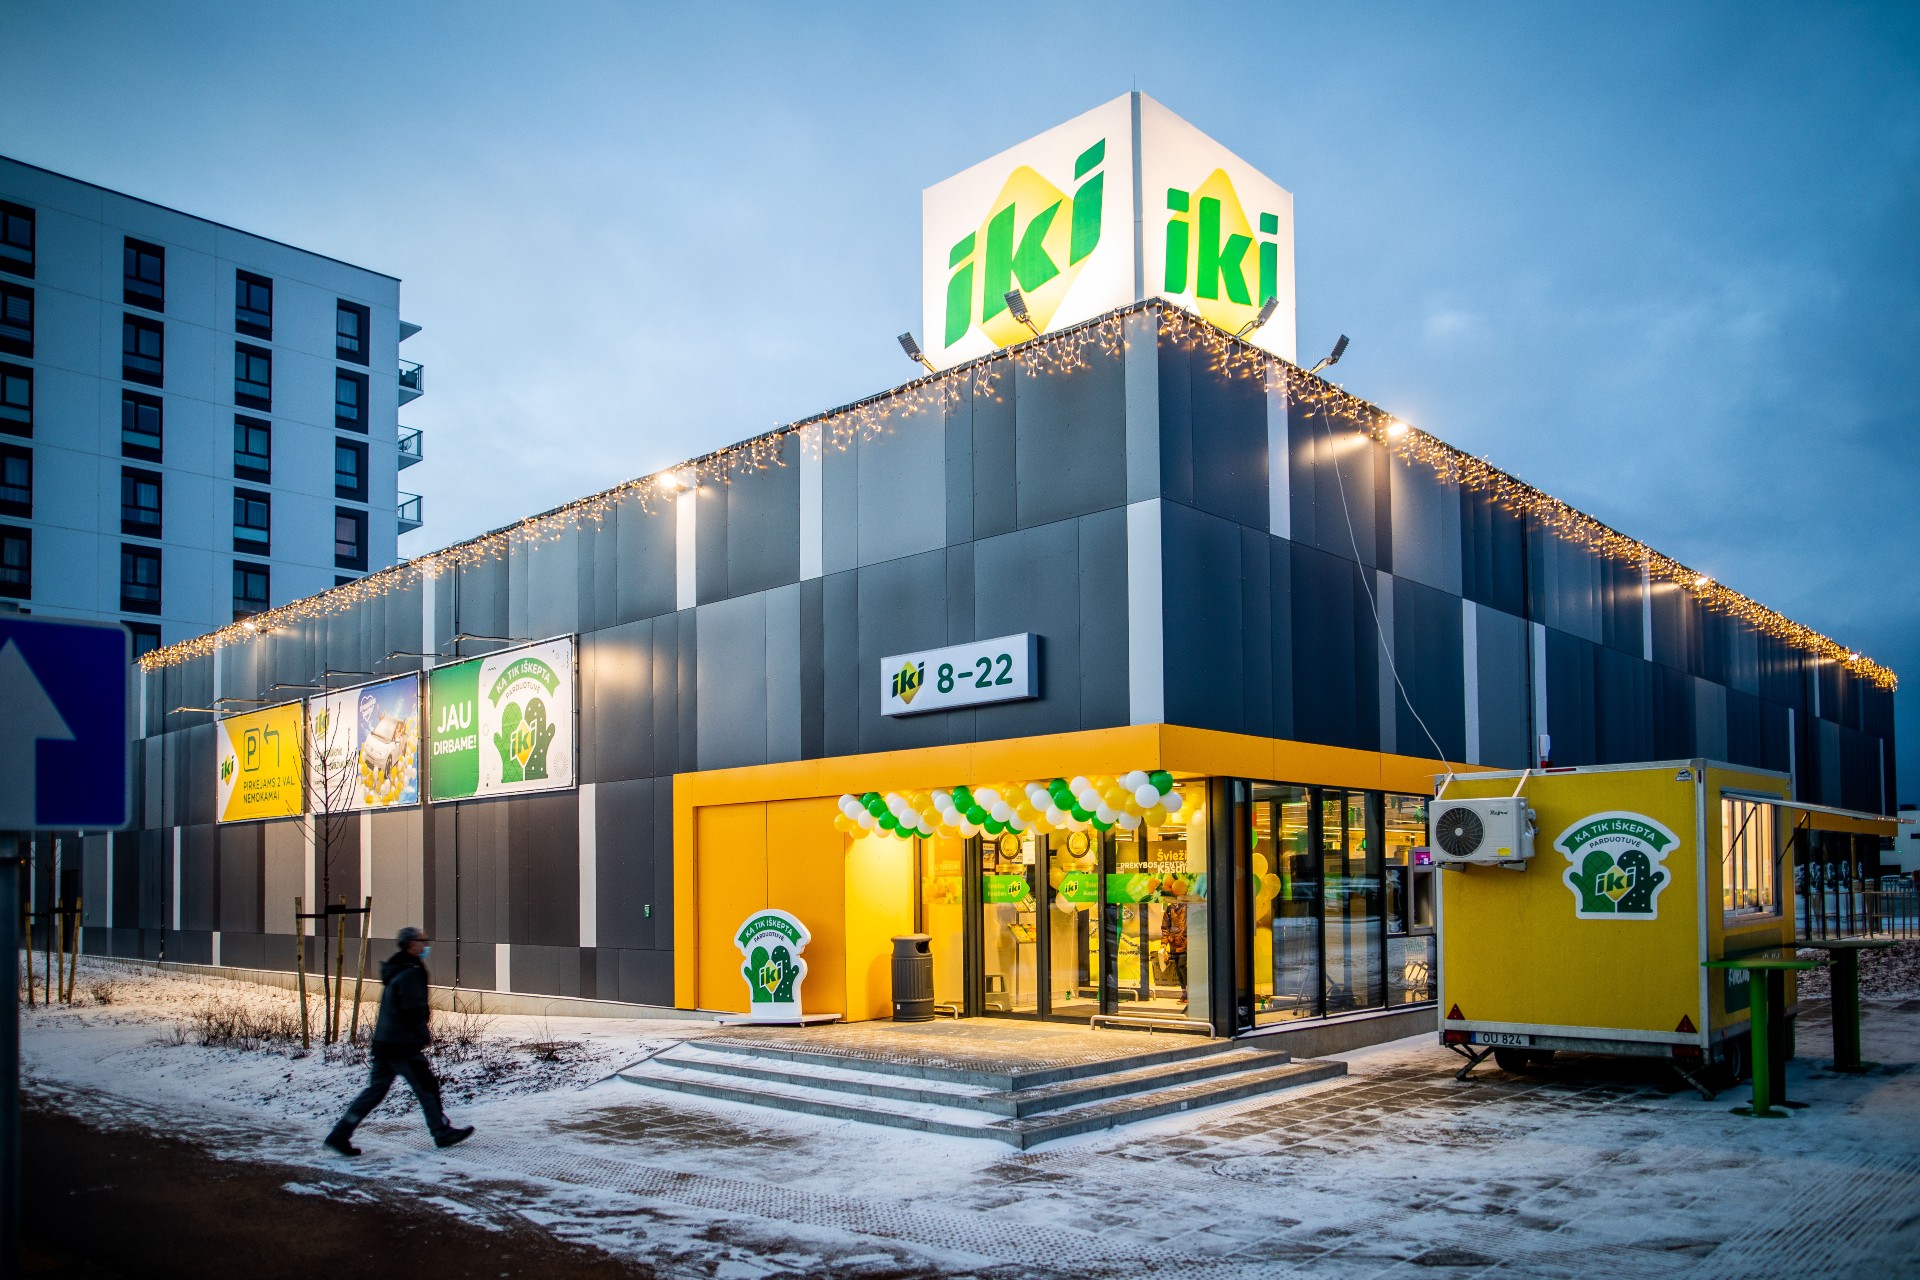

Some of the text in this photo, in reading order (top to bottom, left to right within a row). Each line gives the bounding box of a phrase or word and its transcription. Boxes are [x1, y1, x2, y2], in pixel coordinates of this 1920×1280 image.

[944, 137, 1106, 349] iki
[1164, 187, 1279, 308] iki
[506, 665, 521, 679] TIK
[521, 660, 551, 684] IŠKEPTA
[892, 661, 925, 698] iki
[437, 700, 472, 734] JAU
[433, 734, 477, 756] DIRBAME!
[511, 719, 538, 757] iki
[221, 755, 235, 780] iki
[277, 776, 281, 788] 2
[243, 790, 280, 804] NEMOKAMAI
[1591, 822, 1608, 834] TIK
[1611, 820, 1656, 842] IŠKEPTA
[1120, 861, 1157, 869] PREKYBOS
[1157, 848, 1188, 862] Švieži
[1008, 881, 1021, 894] iki
[1065, 881, 1079, 894] iki
[1596, 867, 1636, 895] iki
[754, 920, 765, 929] TIK
[766, 918, 792, 936] IŠKEPTA
[760, 961, 783, 987] iki
[1482, 1033, 1522, 1045] OU 824
